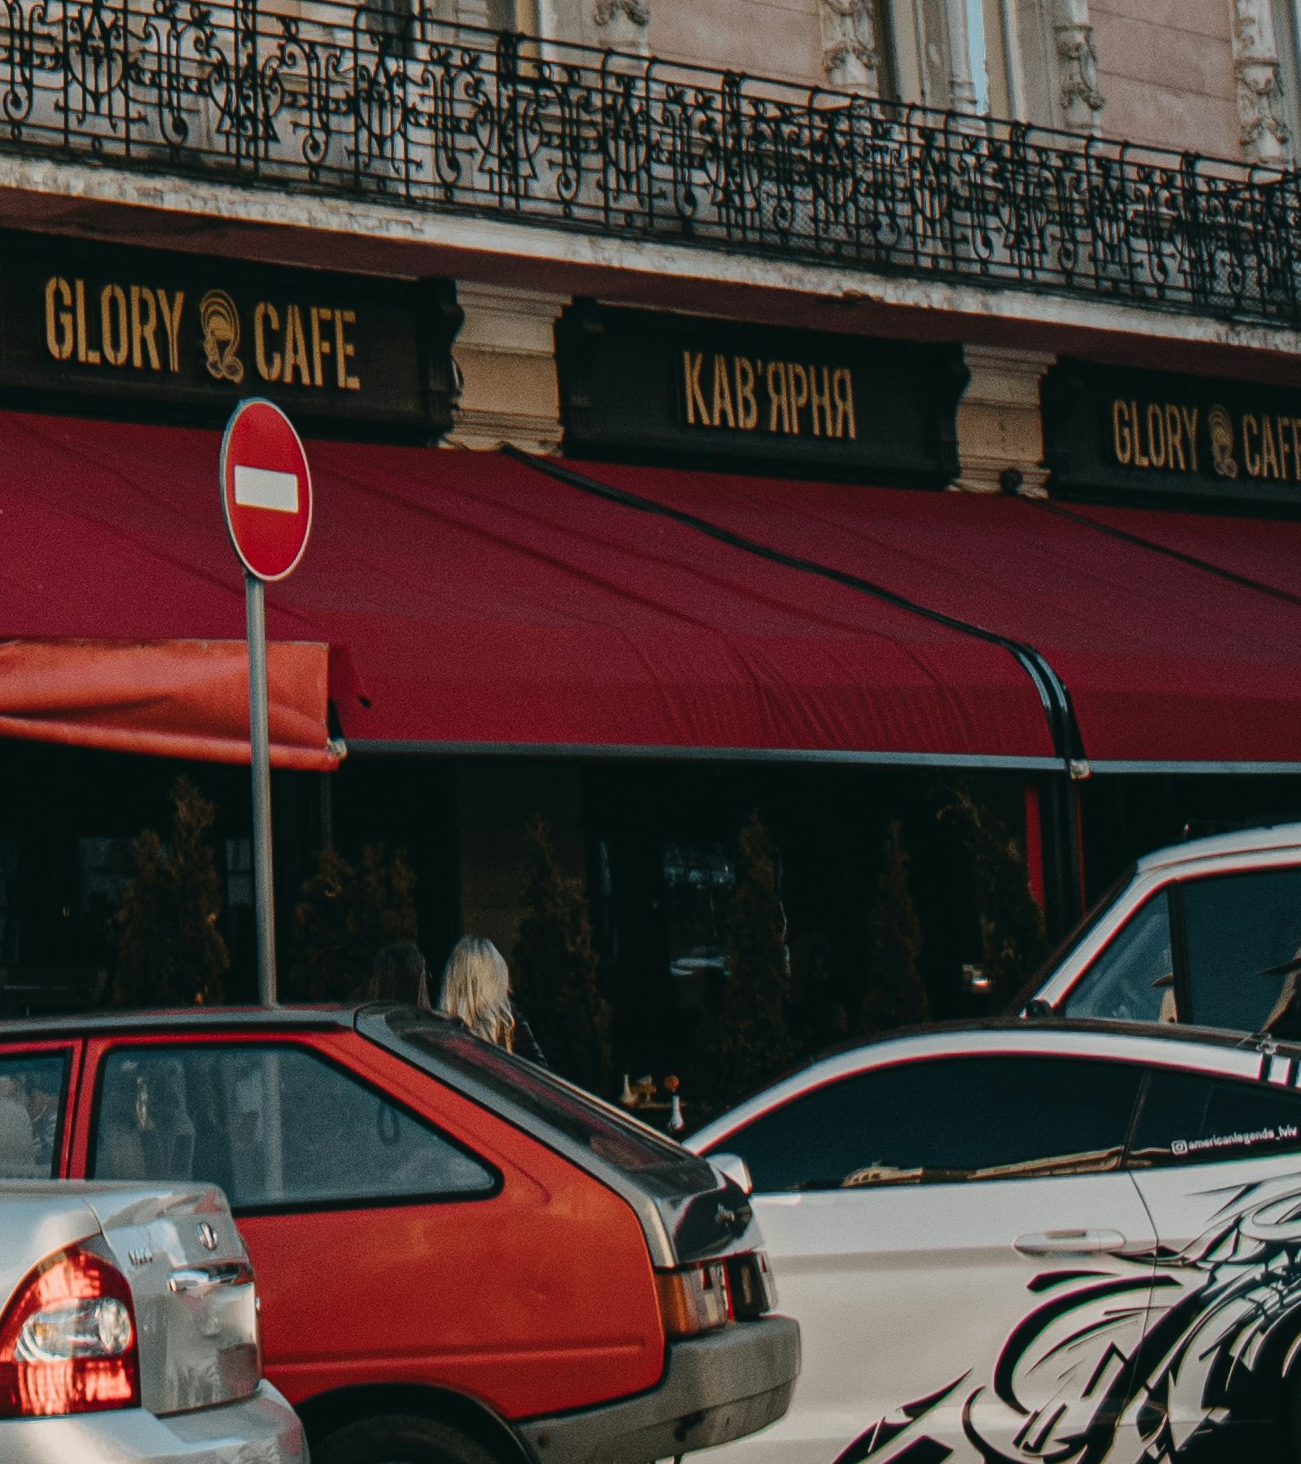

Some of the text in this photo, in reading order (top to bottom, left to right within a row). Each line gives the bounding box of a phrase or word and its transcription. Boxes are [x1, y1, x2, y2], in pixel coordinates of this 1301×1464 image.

[45, 276, 361, 391] GLORY CAFE
[682, 349, 857, 441] КАВ'ЯРНЯ
[1112, 398, 1199, 473] GLORY
